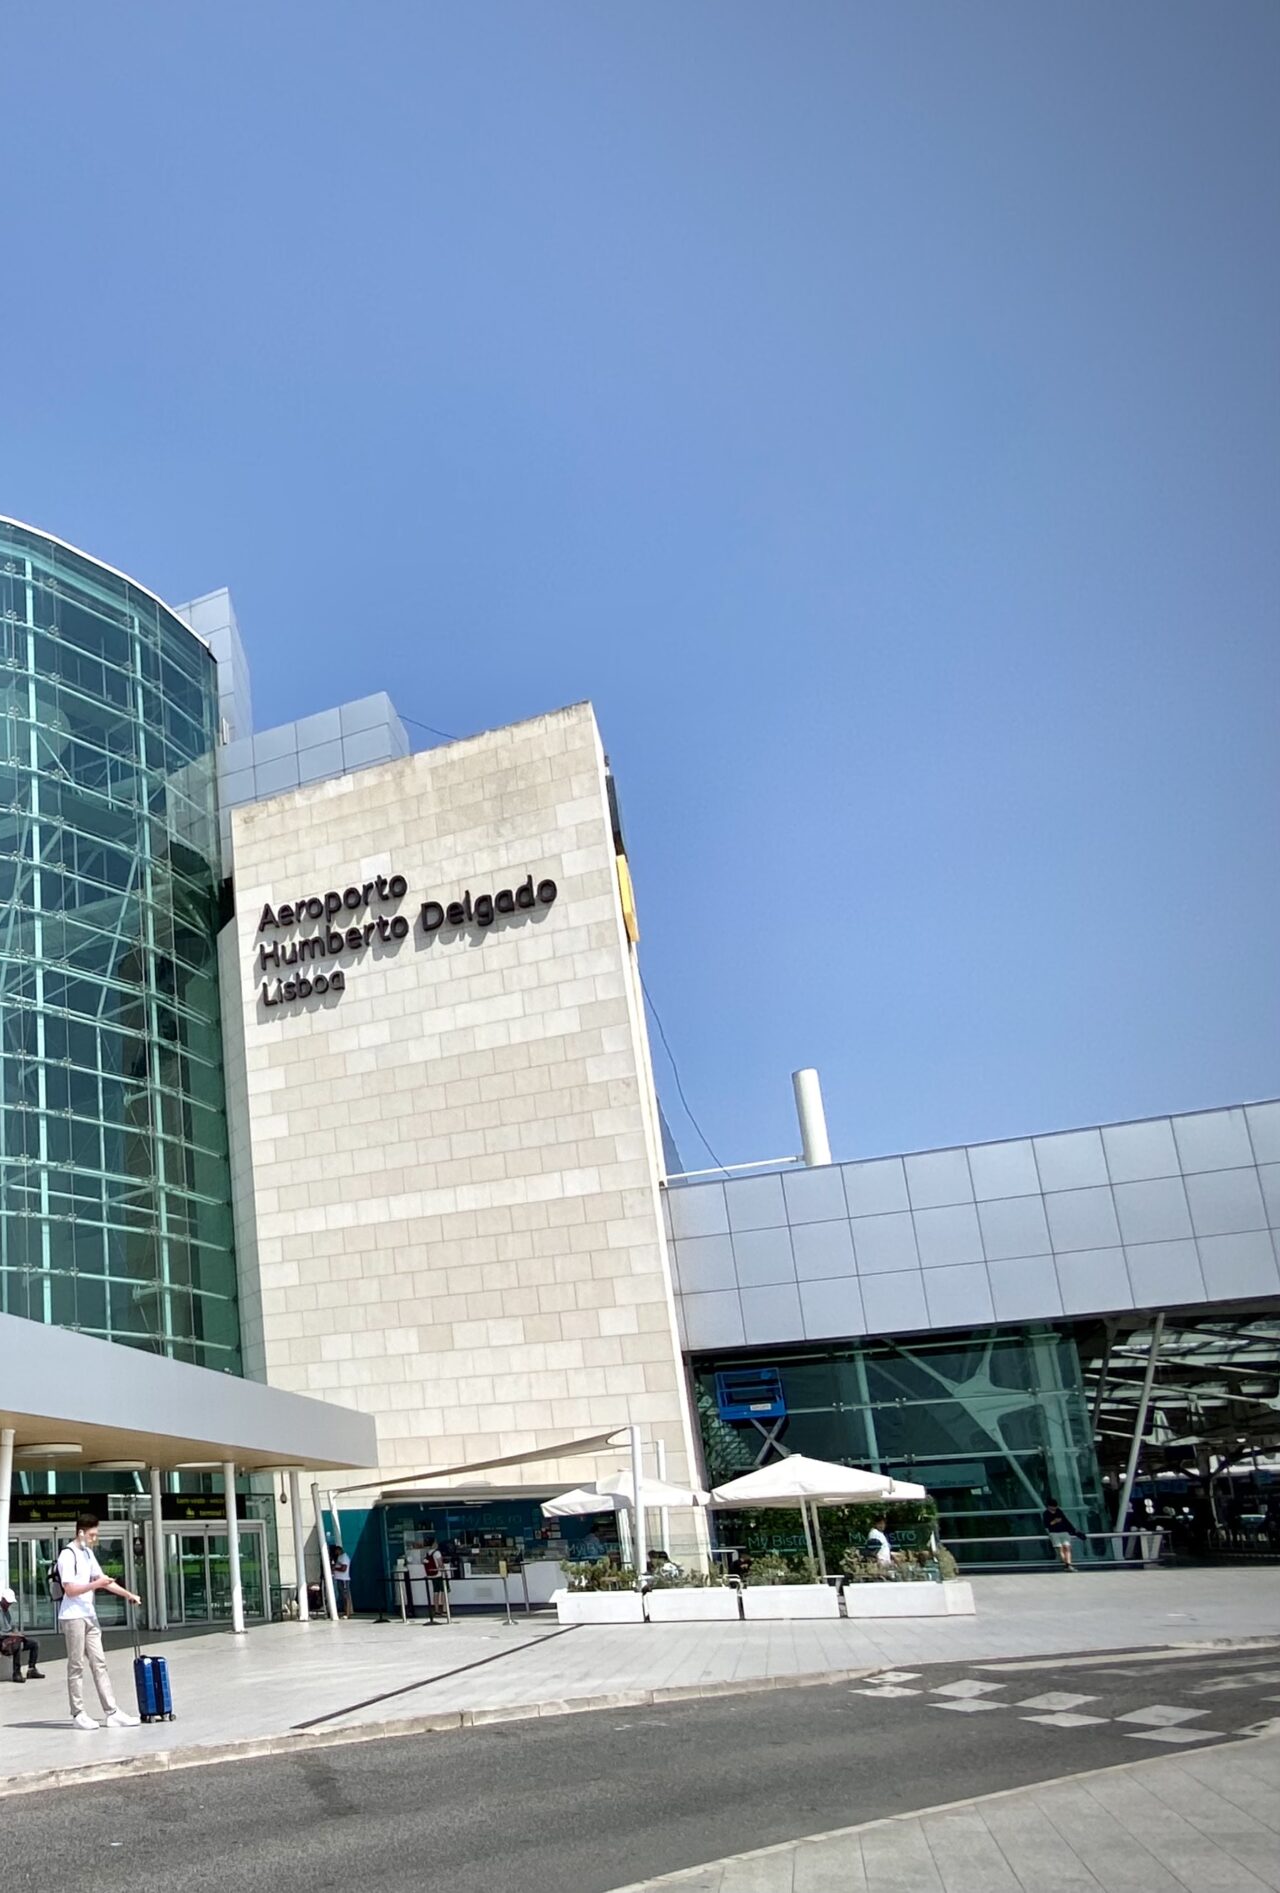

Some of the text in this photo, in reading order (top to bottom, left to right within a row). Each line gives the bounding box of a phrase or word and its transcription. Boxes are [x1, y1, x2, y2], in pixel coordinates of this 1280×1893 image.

[258, 874, 408, 932] Aeroporto
[259, 874, 558, 970] Humberto Delgado
[262, 970, 345, 1007] Lisboa
